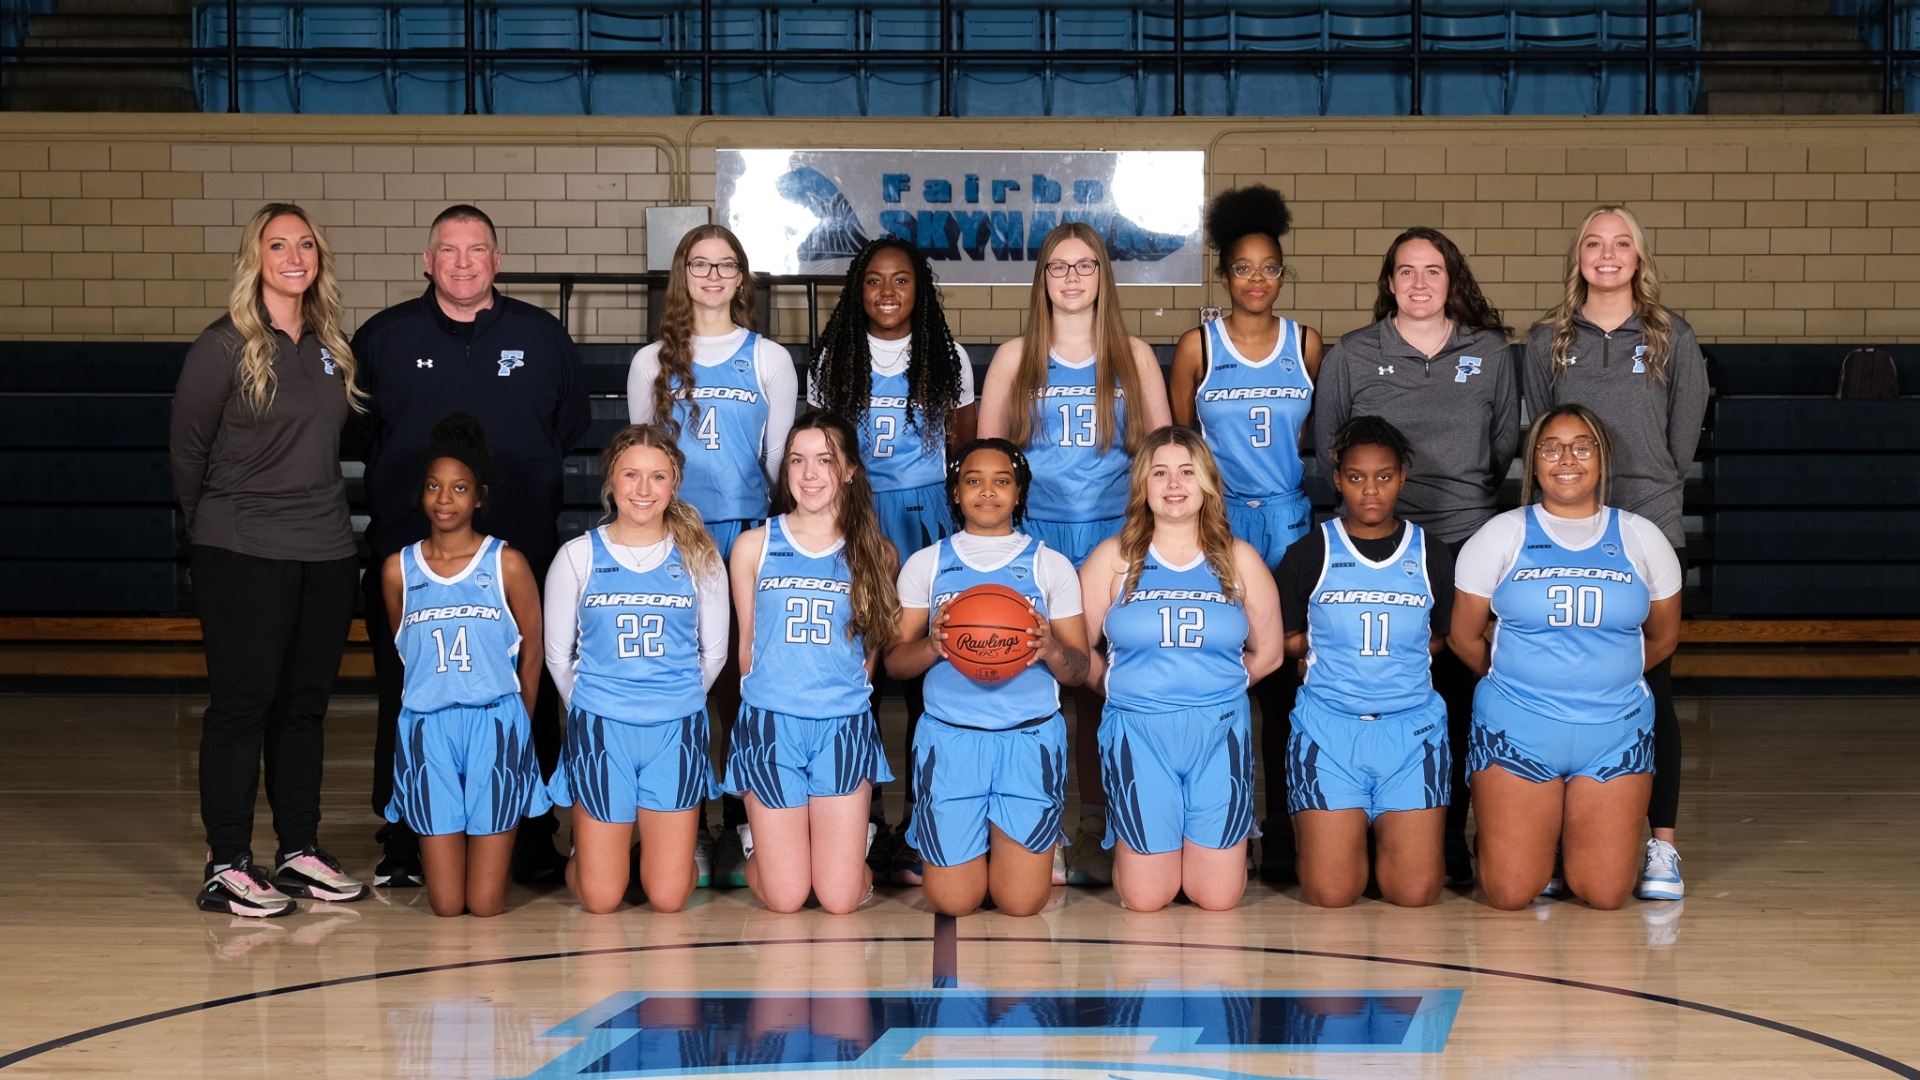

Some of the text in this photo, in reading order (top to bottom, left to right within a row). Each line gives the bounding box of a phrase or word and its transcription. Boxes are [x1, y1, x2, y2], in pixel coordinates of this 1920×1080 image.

[882, 173, 1104, 203] Fairbo
[879, 210, 1186, 261] SKYHA
[671, 385, 759, 404] IRBORN
[1204, 386, 1309, 402] FAIRBORN
[697, 405, 720, 450] 4
[872, 415, 896, 458] 2
[1058, 404, 1097, 447] 13
[1249, 405, 1272, 448] 3
[758, 576, 853, 594] FAIRBOR
[1512, 566, 1632, 584] FAIRBORN
[405, 604, 501, 630] FAIRBORN
[584, 592, 693, 609] FAIRBORN
[1318, 590, 1427, 608] FAIRBORN
[1547, 584, 1603, 628] 30
[616, 613, 665, 659] 22
[785, 597, 835, 645] 25
[1158, 605, 1205, 649] 12
[1359, 611, 1390, 656] 11
[431, 625, 472, 673] 14
[957, 633, 1020, 655] Rawlings
